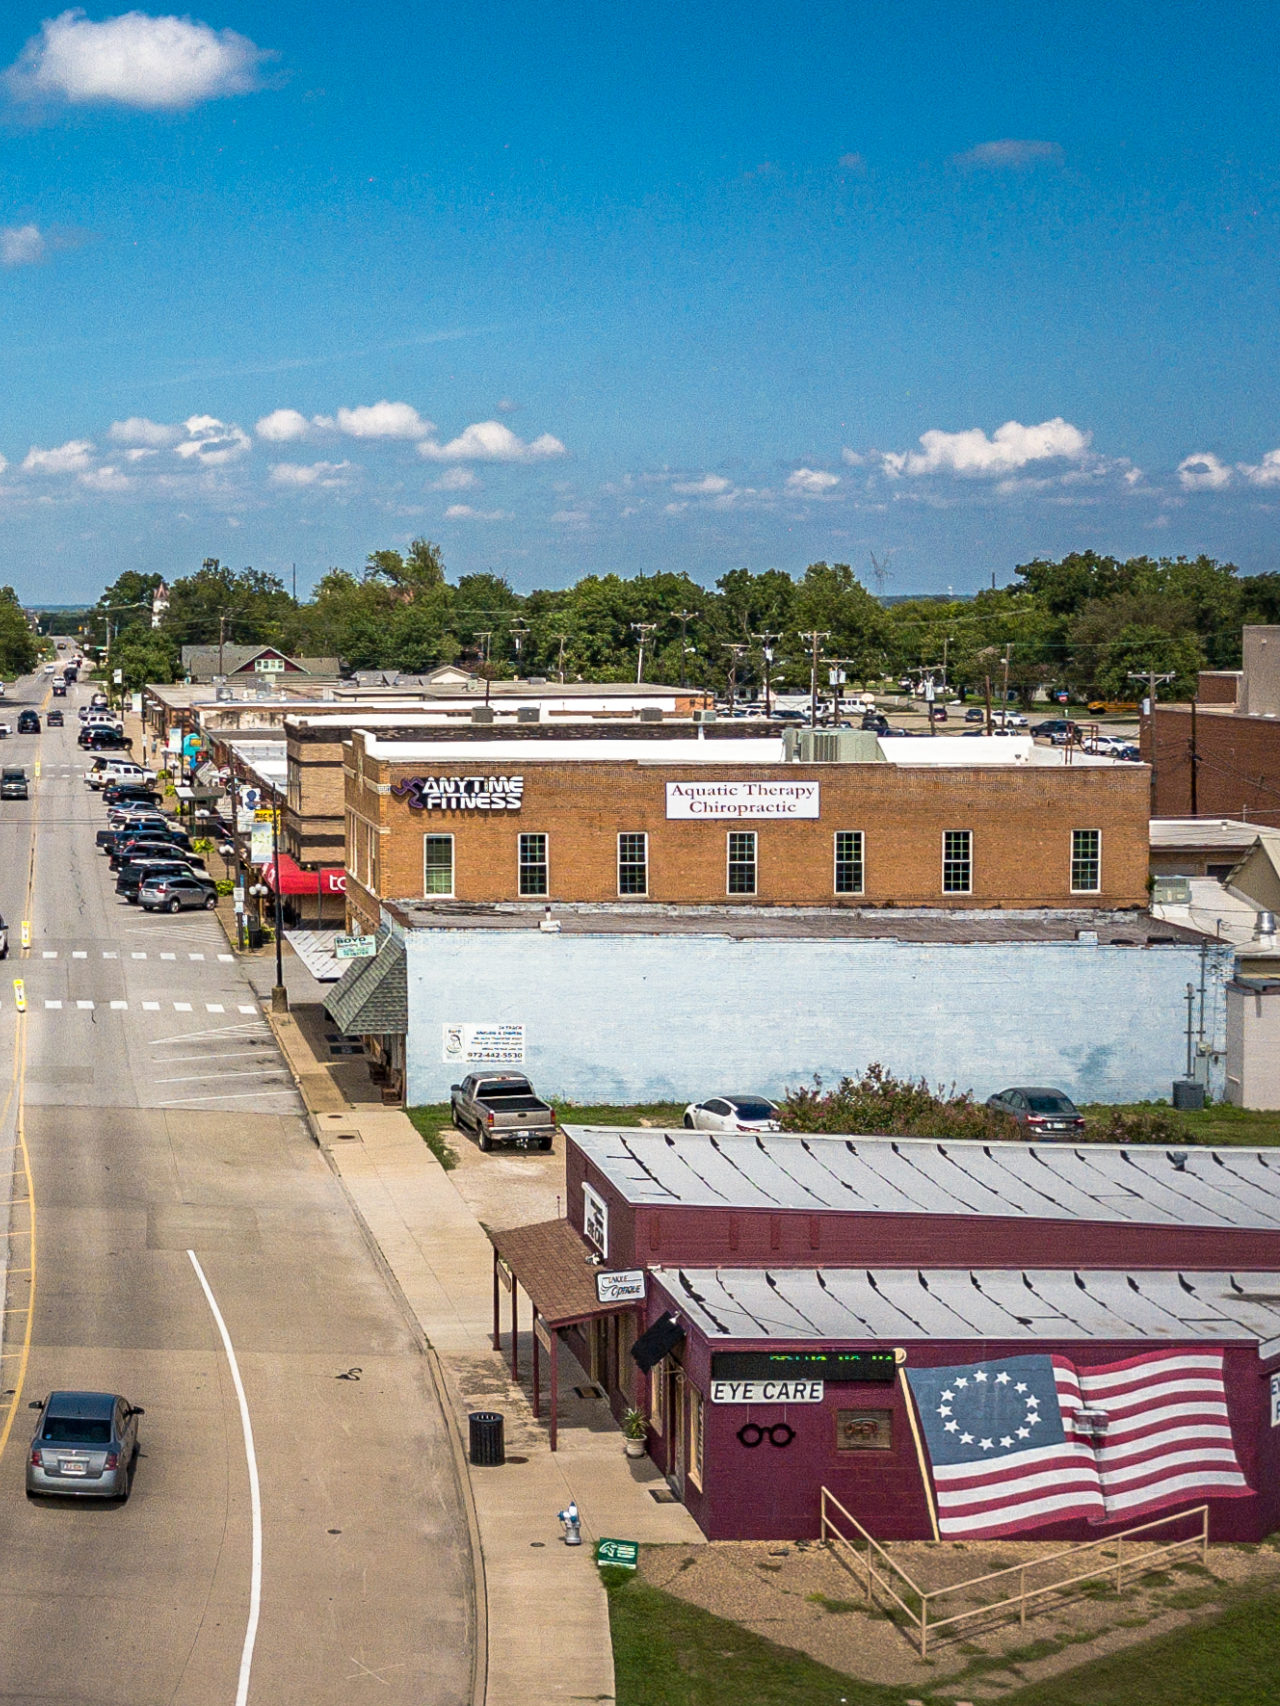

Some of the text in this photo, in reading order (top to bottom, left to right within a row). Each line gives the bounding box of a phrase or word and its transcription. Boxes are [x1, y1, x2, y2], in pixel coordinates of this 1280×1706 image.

[422, 776, 523, 793] ANYTIME
[672, 784, 815, 800] Aquatic Therapy
[427, 793, 521, 809] FITNESS
[689, 801, 797, 816] Chiropractic
[714, 1382, 821, 1400] EYE CARE
